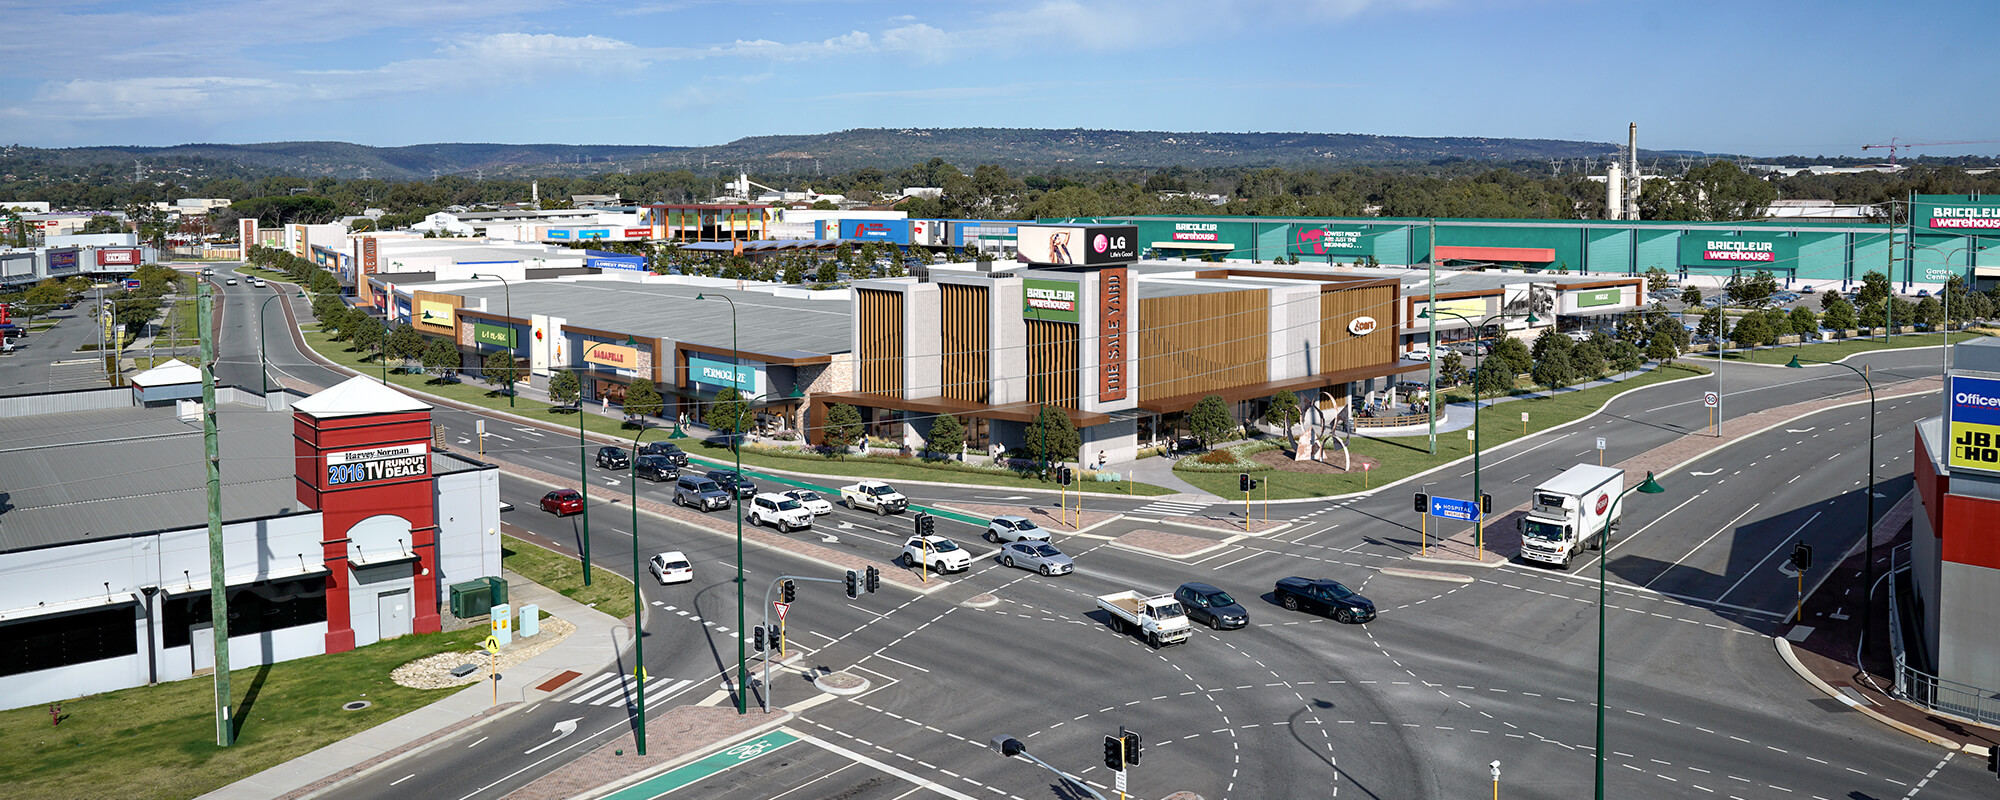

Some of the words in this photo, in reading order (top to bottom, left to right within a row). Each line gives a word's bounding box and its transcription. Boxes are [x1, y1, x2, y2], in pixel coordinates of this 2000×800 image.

[366, 240, 375, 260] YARD
[1110, 236, 1126, 249] LG
[1709, 251, 1770, 260] warehouse
[1109, 275, 1120, 316] YARD
[1029, 299, 1070, 310] warehouse
[1109, 319, 1120, 360] SALE
[1109, 363, 1120, 394] THE
[1956, 431, 1991, 448] JB
[345, 451, 375, 460] Harvey
[377, 447, 409, 456] Norman
[1964, 446, 2000, 463] HO
[385, 456, 425, 468] RUNOUT
[329, 463, 364, 484] 2016
[365, 460, 384, 480] TV
[385, 463, 425, 478] DEALS
[1443, 504, 1471, 513] HOSPITAL
